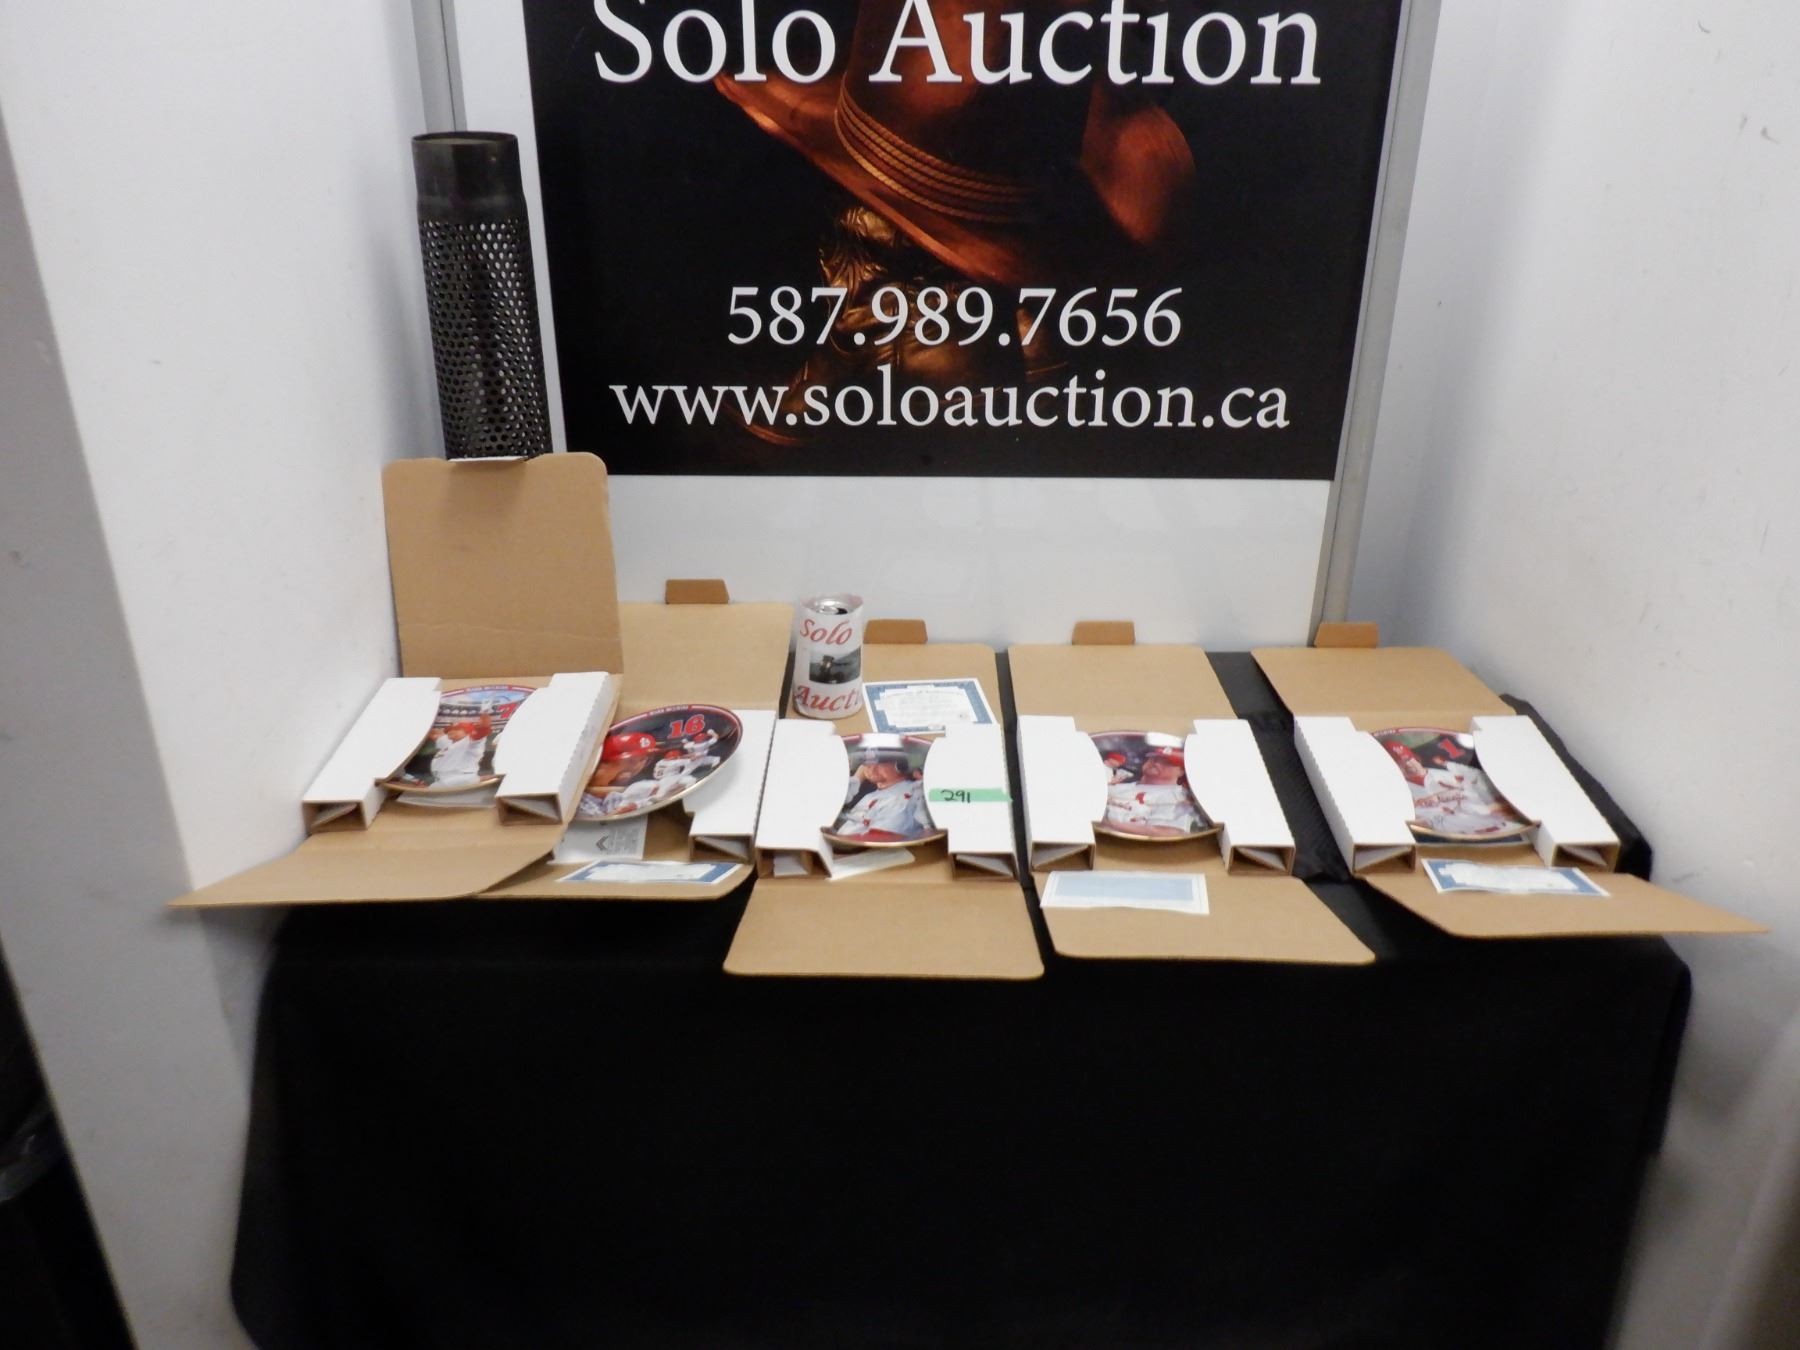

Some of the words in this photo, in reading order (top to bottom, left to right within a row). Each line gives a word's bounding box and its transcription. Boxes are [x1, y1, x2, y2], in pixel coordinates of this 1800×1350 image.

[593, 0, 837, 84] Solo
[868, 0, 1322, 86] Auction
[728, 286, 1182, 347] 587.989.7656
[609, 363, 1291, 429] www.soloauction.ca
[799, 618, 854, 646] Solo
[667, 713, 706, 739] 16
[939, 788, 971, 803] 291
